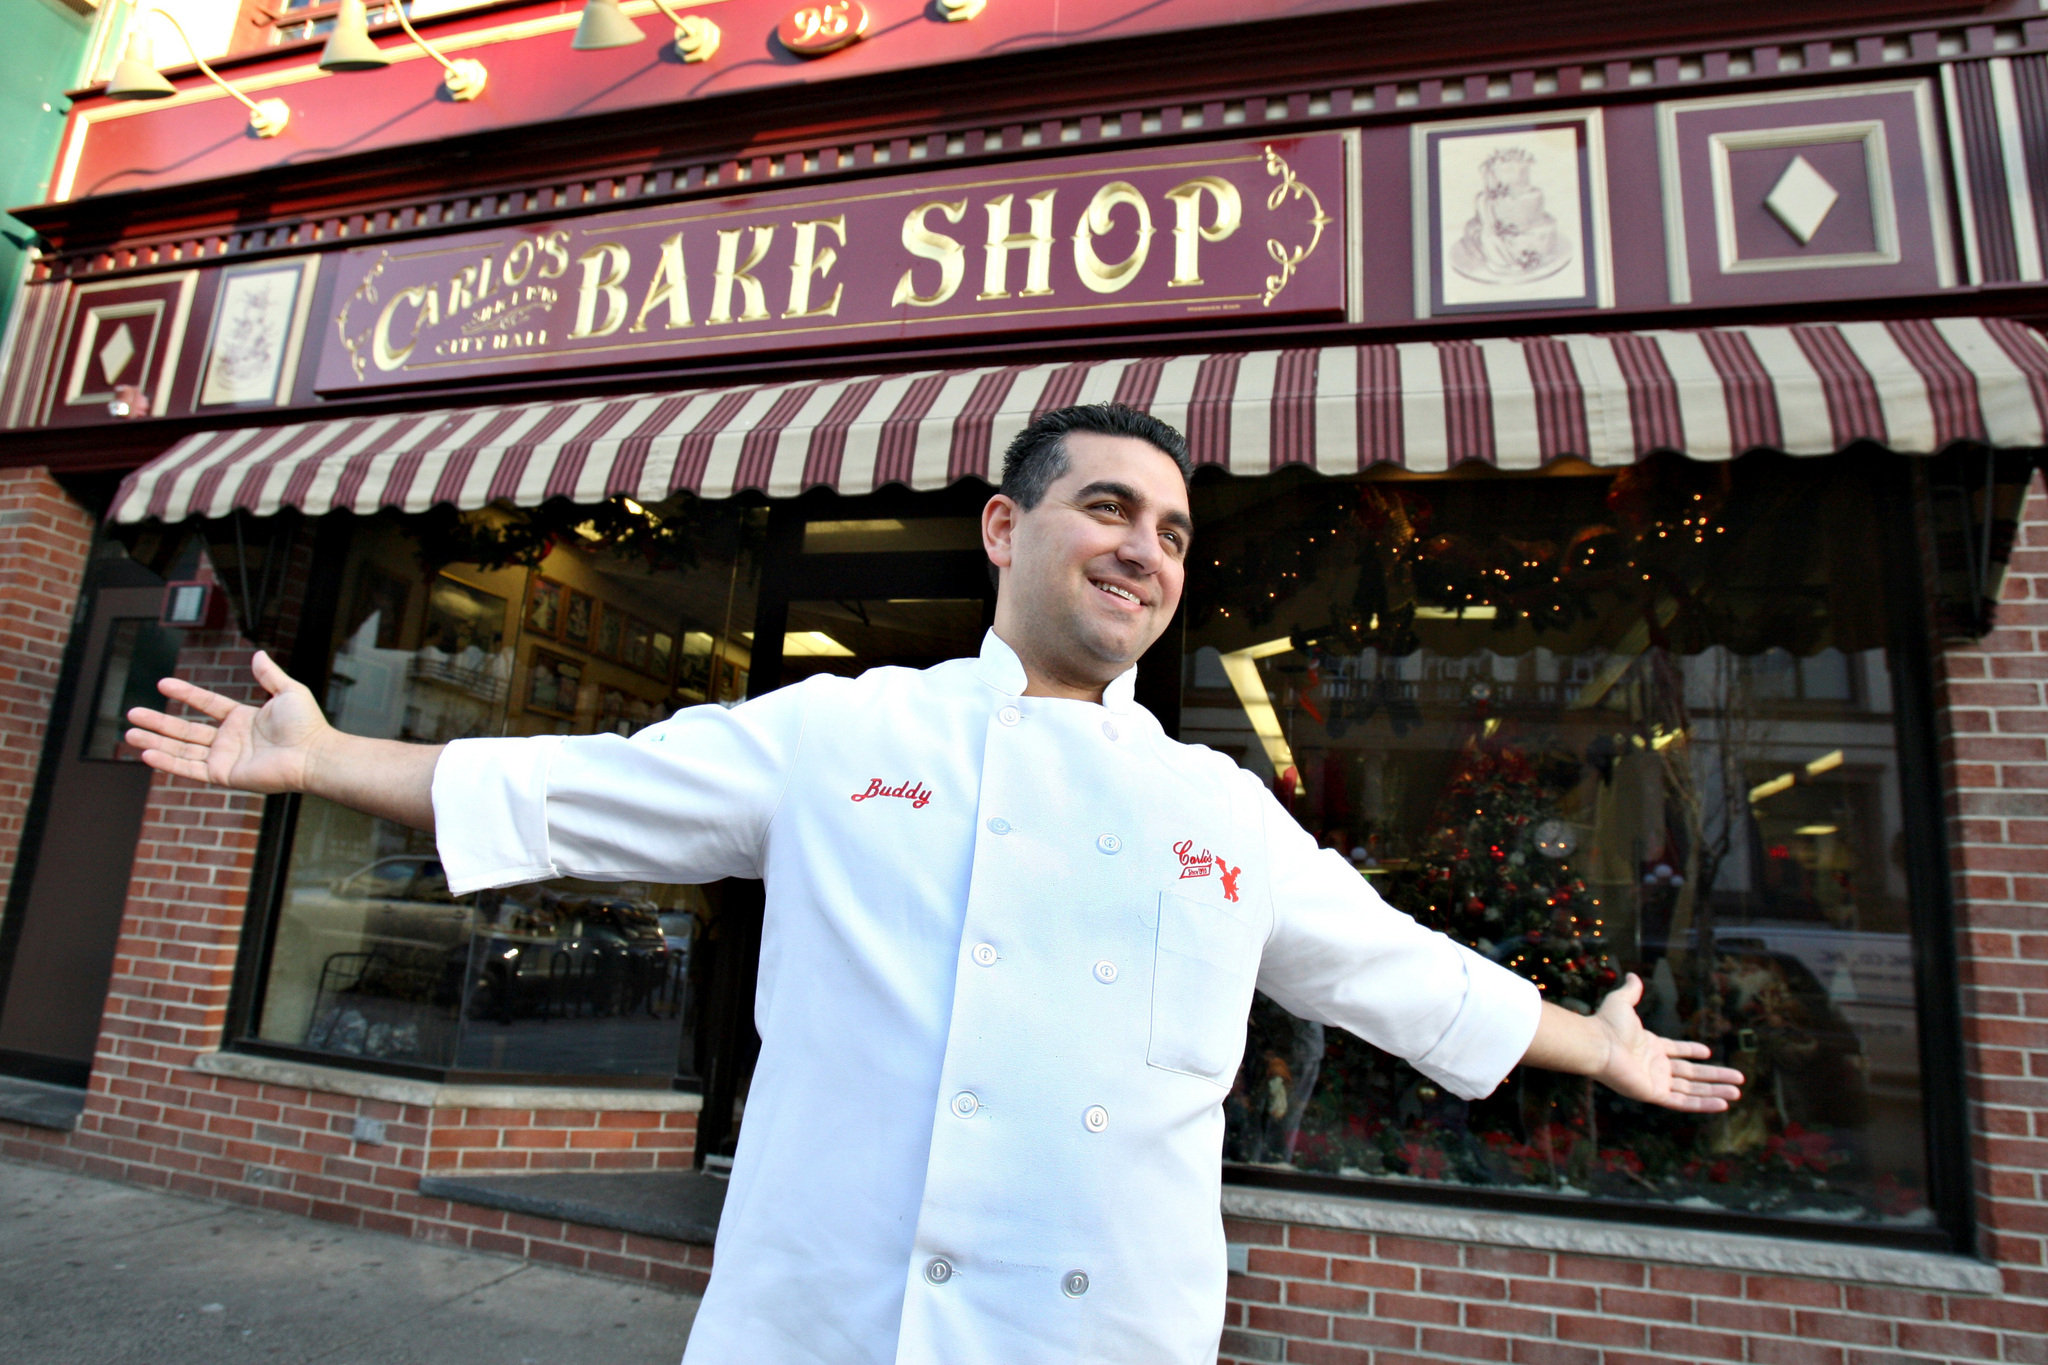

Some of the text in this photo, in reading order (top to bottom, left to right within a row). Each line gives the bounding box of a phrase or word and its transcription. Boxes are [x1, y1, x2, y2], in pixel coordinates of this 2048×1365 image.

[794, 0, 849, 45] 95
[567, 176, 1243, 340] BAKE SHOP
[373, 230, 571, 371] CARLO'S
[435, 329, 550, 355] CITY HALL
[851, 778, 932, 808] Buddy
